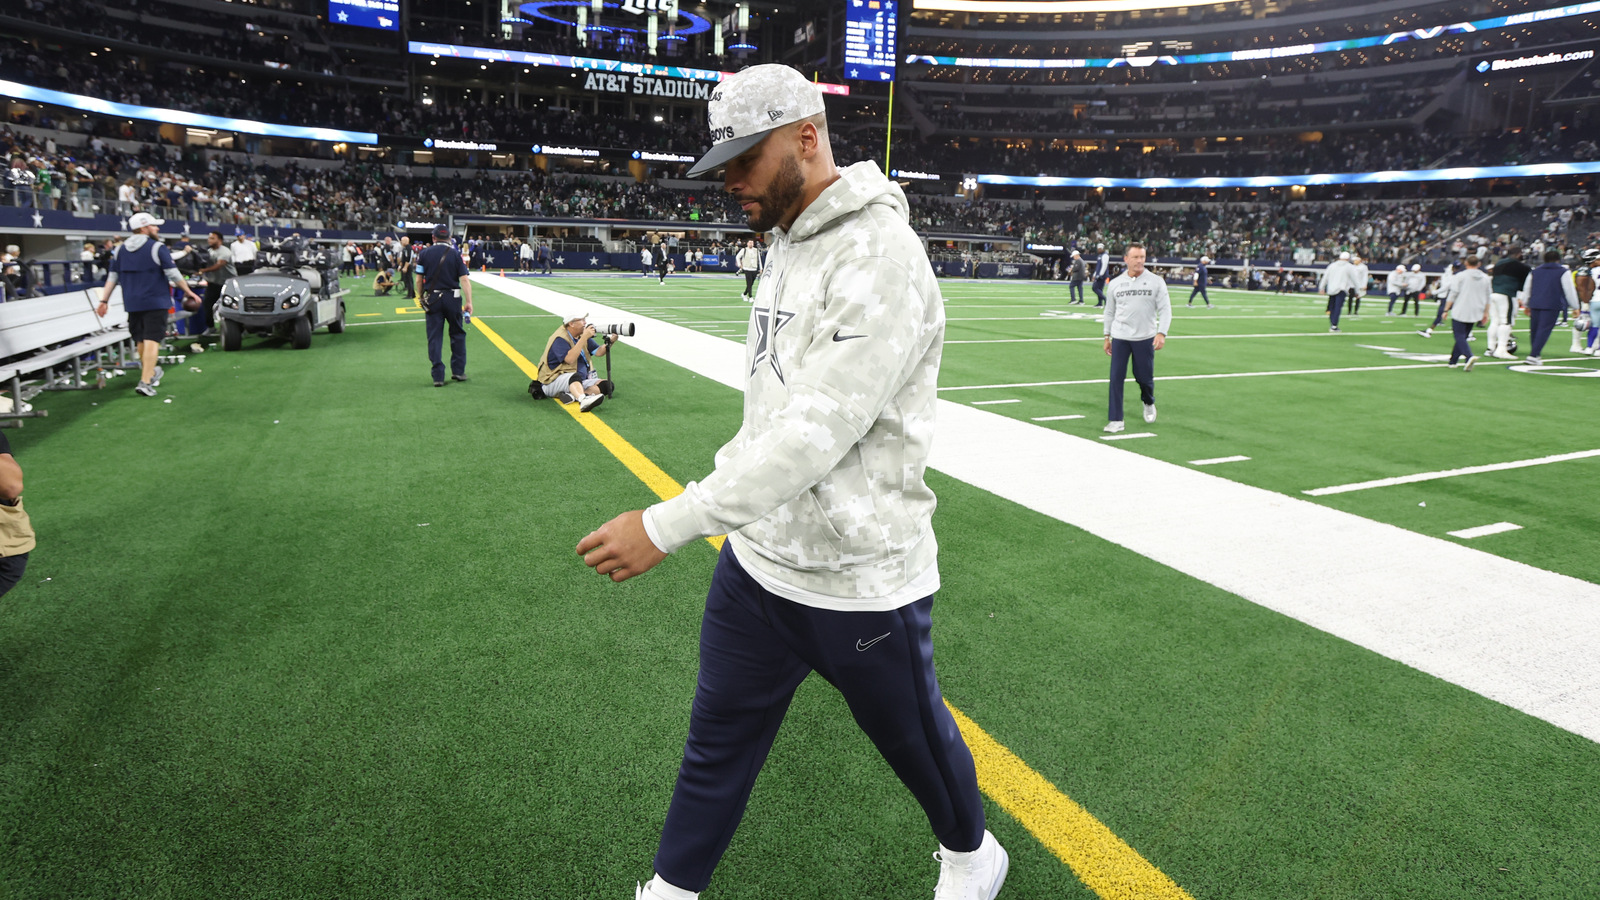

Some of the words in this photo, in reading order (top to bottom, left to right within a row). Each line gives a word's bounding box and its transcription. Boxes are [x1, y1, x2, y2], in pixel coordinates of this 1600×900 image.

[1492, 50, 1594, 70] Blockchain.com
[584, 72, 629, 93] AT&T
[633, 76, 709, 100] STADIUM
[710, 126, 734, 142] BOYS
[435, 139, 496, 150] Blockchain.com
[542, 146, 599, 156] Blockchain.com
[641, 152, 695, 162] Blockchain.com
[1116, 289, 1153, 298] COWBOYS
